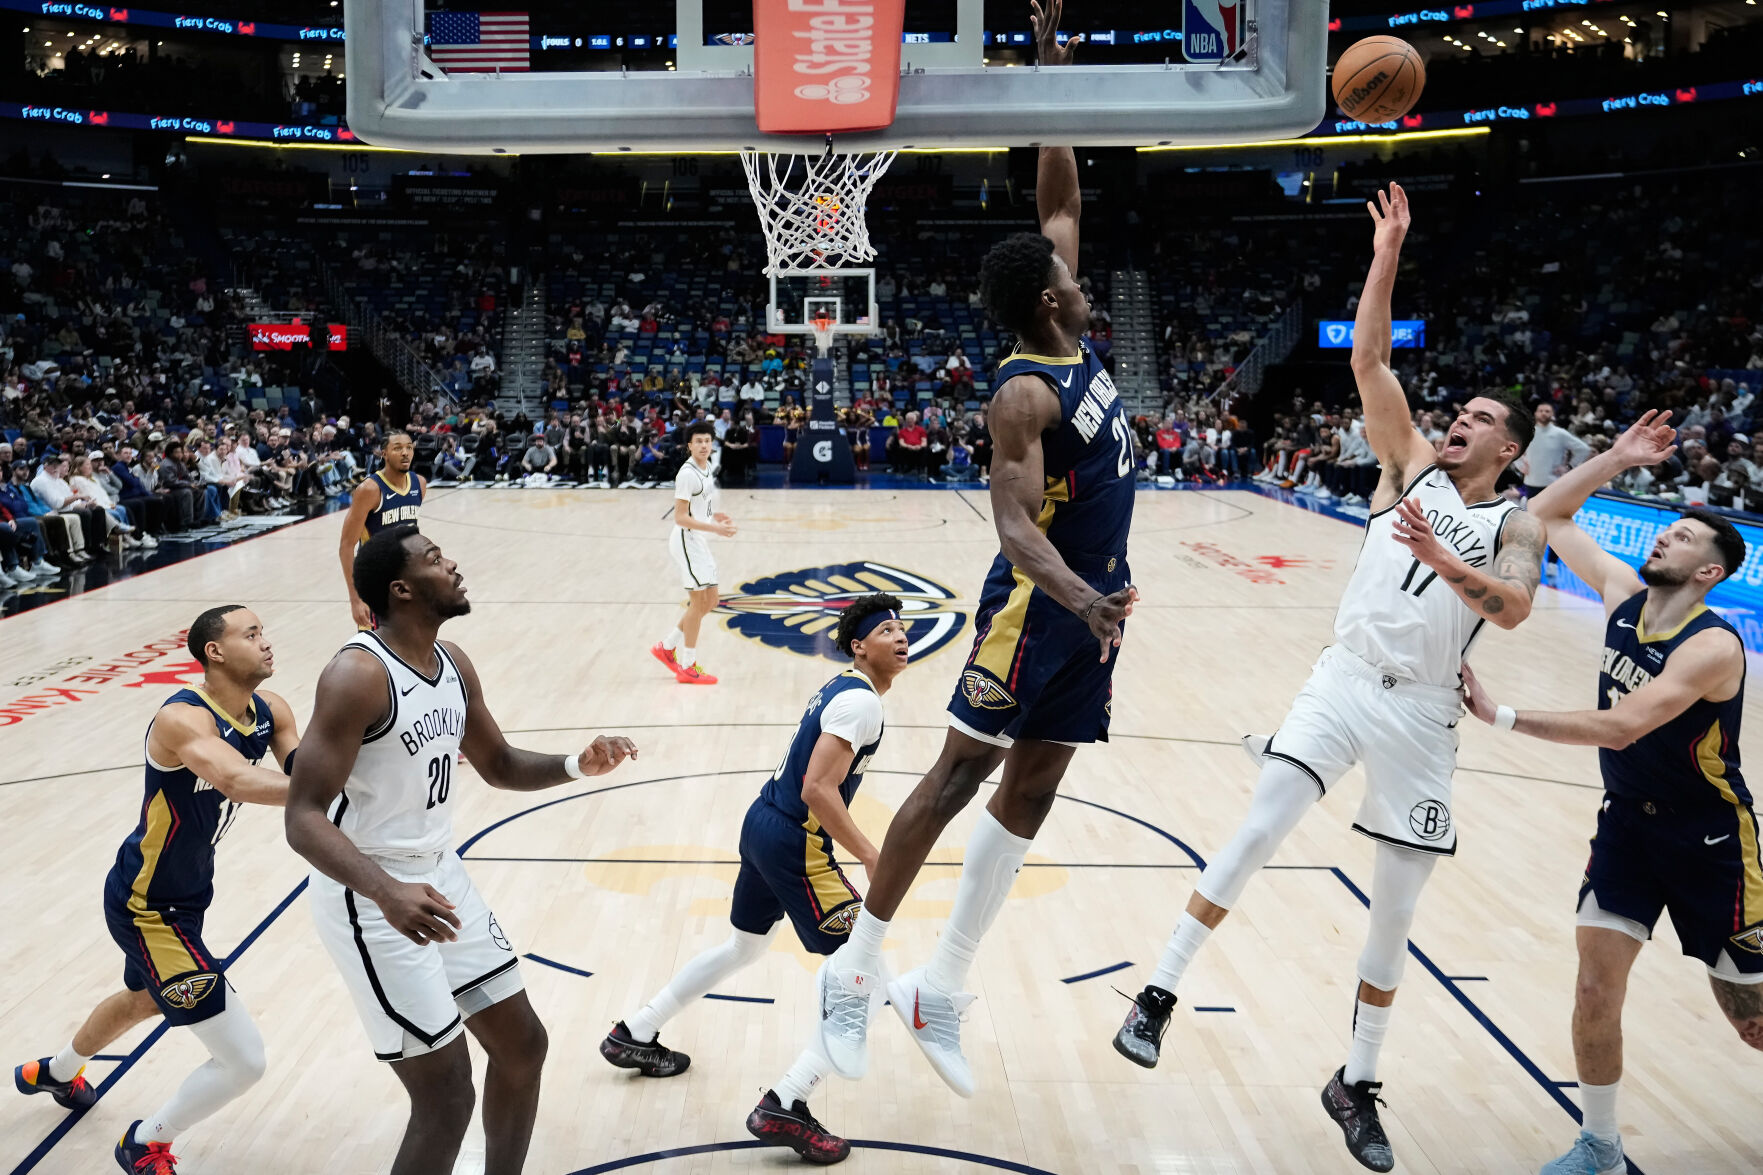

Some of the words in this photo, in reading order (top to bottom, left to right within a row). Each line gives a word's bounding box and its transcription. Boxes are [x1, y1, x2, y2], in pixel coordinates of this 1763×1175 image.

[42, 2, 73, 15] Fiery
[75, 4, 104, 20] Crab
[1389, 13, 1418, 27] Fiery
[1420, 10, 1449, 22] Crab
[175, 16, 203, 29] Fiery
[206, 18, 232, 33] Crab
[299, 27, 328, 40] Fiery
[330, 28, 346, 40] Cr
[655, 37, 663, 46] 7
[904, 33, 929, 43] NETS
[1134, 32, 1161, 43] Fiery
[1163, 30, 1182, 40] Cra
[1190, 33, 1217, 54] NBA
[1341, 71, 1388, 113] Wilson
[1743, 81, 1763, 95] Fie
[1602, 97, 1636, 112] Fiery
[1638, 93, 1669, 106] Crab
[22, 105, 51, 119] Fiery
[54, 107, 83, 124] Crab
[1464, 109, 1496, 123] Fiery
[1498, 107, 1530, 119] Crab
[151, 117, 180, 130] Fiery
[183, 118, 211, 133] Crab
[273, 126, 302, 138] Fiery
[304, 126, 332, 139] Crab
[342, 154, 369, 173] 105
[671, 158, 698, 176] 106
[1294, 148, 1324, 167] 108
[271, 331, 311, 343] SMOOTH
[1070, 391, 1105, 445] NEW
[812, 440, 833, 462] G
[1111, 408, 1135, 478] 21
[381, 507, 400, 526] NEW
[1400, 508, 1487, 568] OOKLYN
[400, 707, 466, 757] BROOKLYN
[426, 753, 451, 810] 20
[1423, 805, 1439, 835] B
